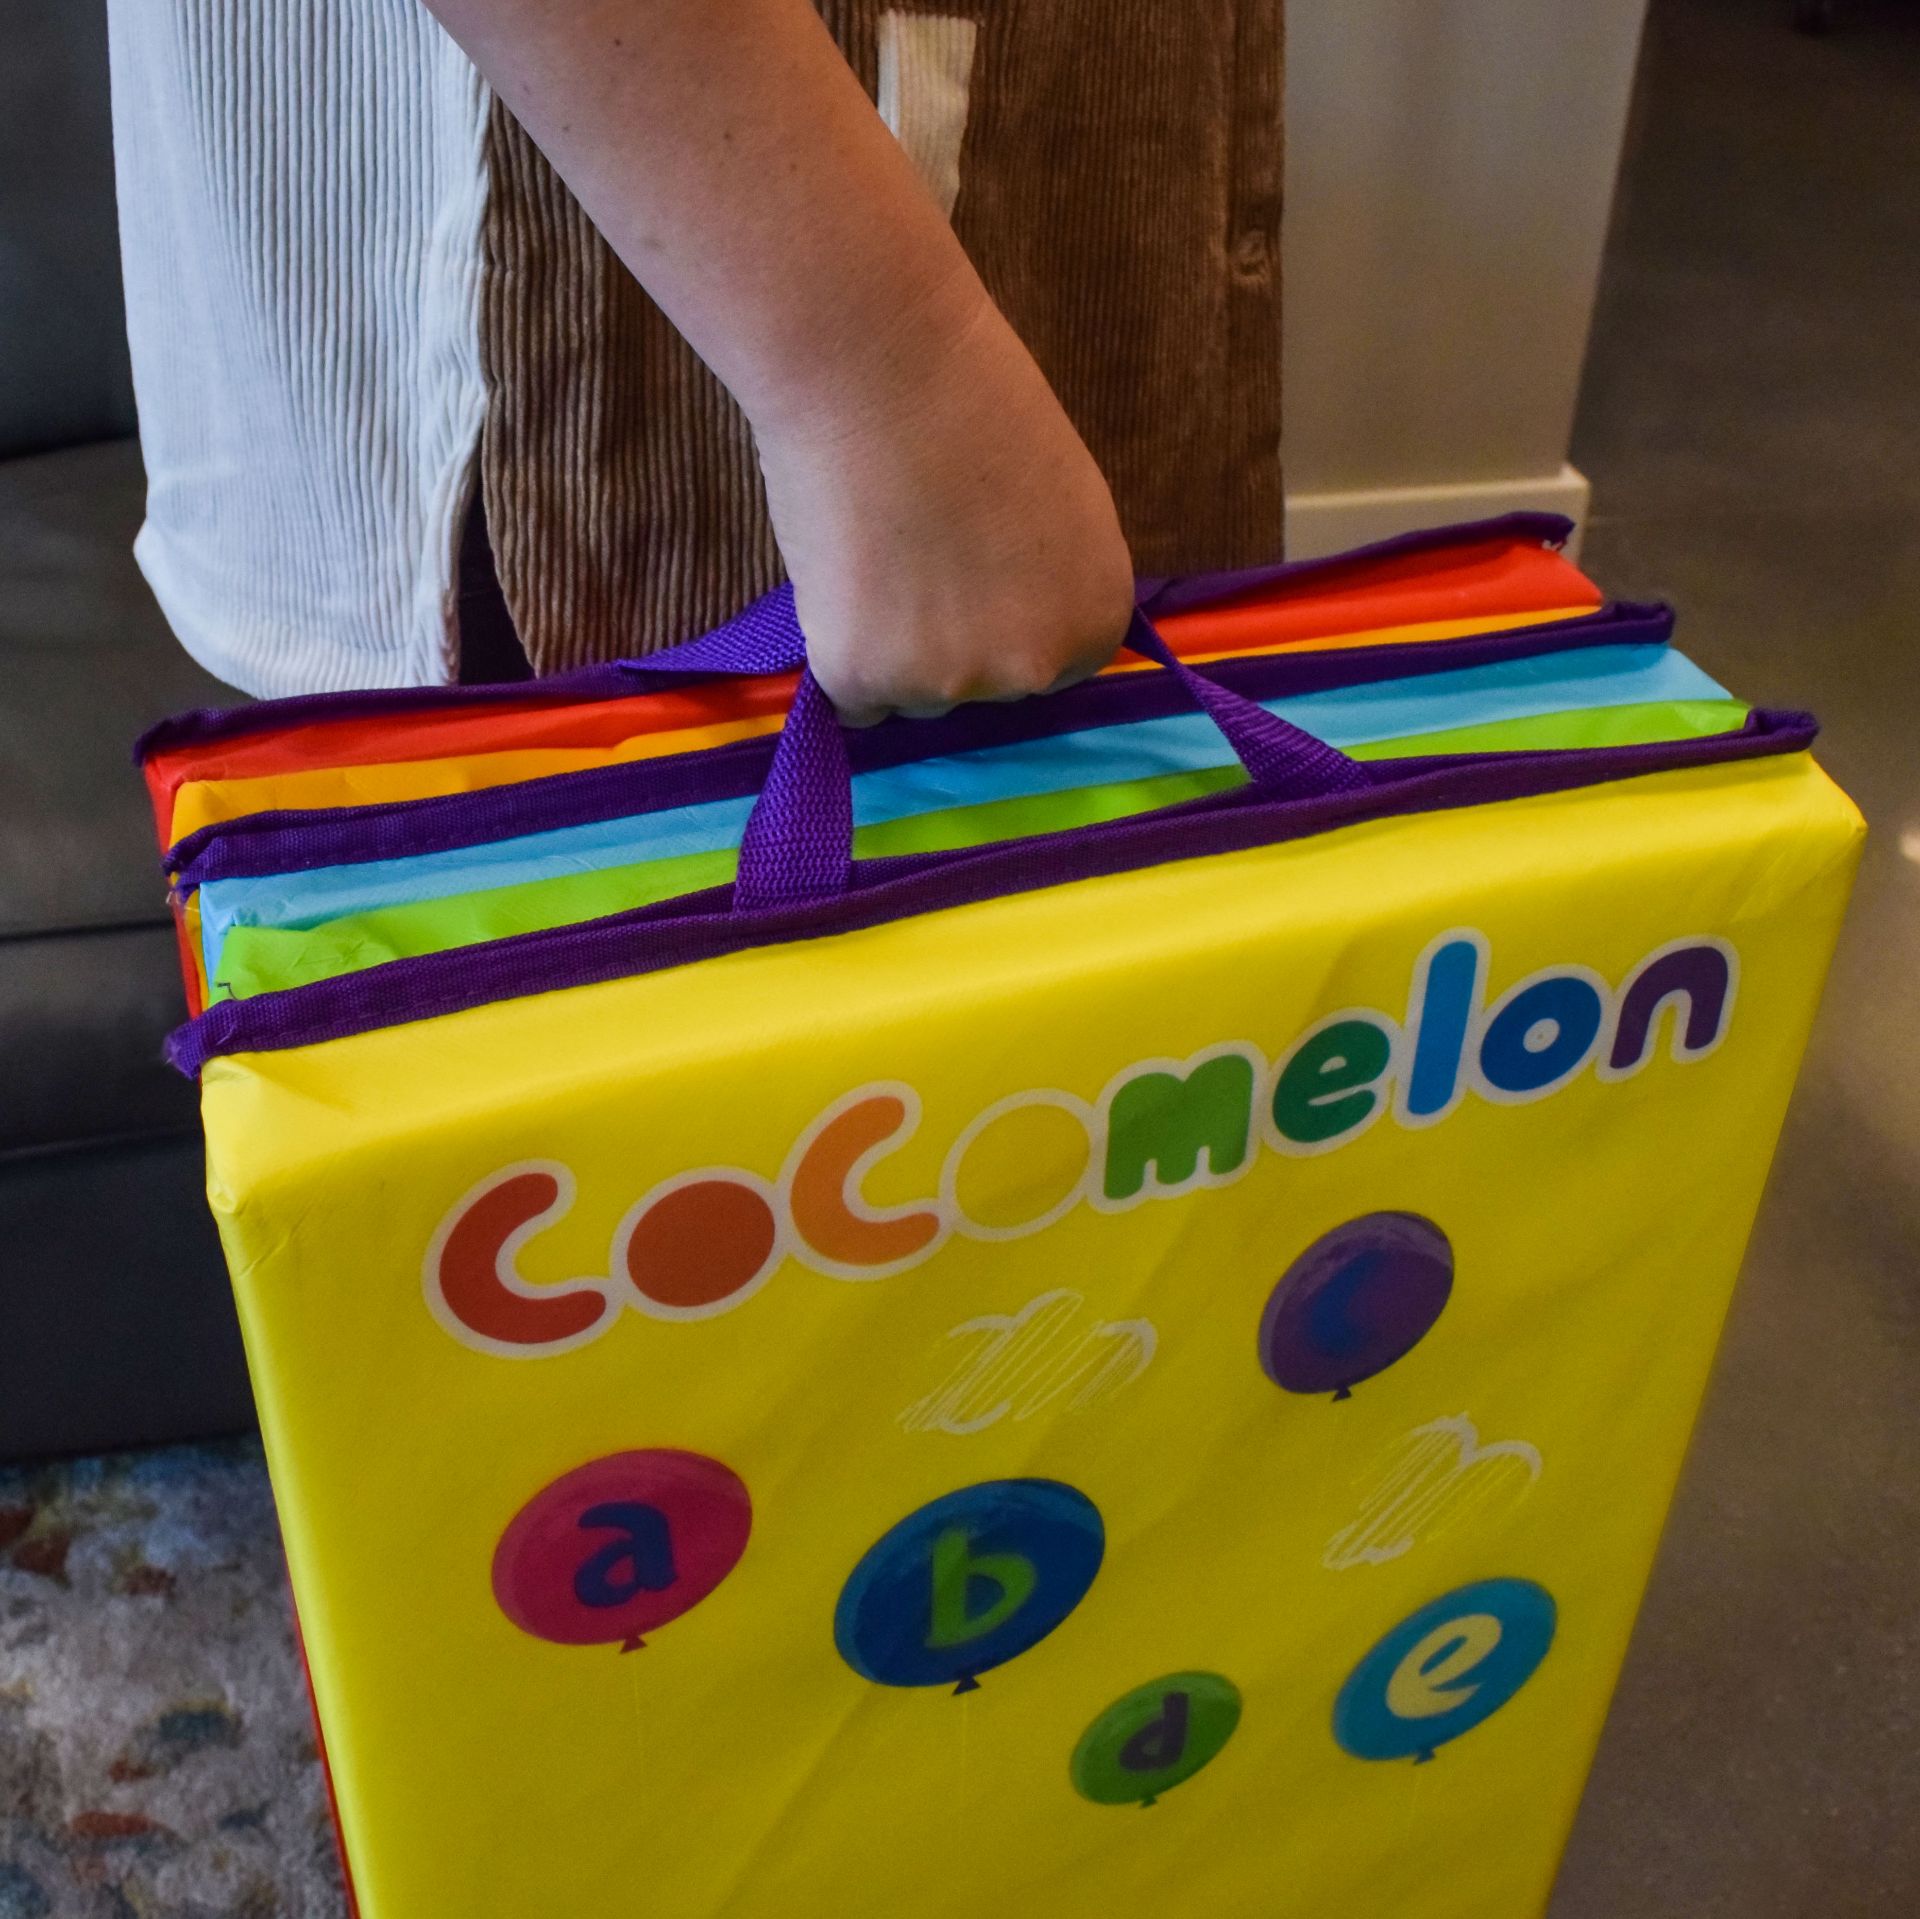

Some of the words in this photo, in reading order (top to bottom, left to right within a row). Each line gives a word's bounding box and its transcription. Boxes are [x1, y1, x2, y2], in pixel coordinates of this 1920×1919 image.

[573, 1501, 678, 1608] a
[924, 1527, 1037, 1650] b
[1386, 1613, 1502, 1718] e
[1118, 1692, 1190, 1771] d
